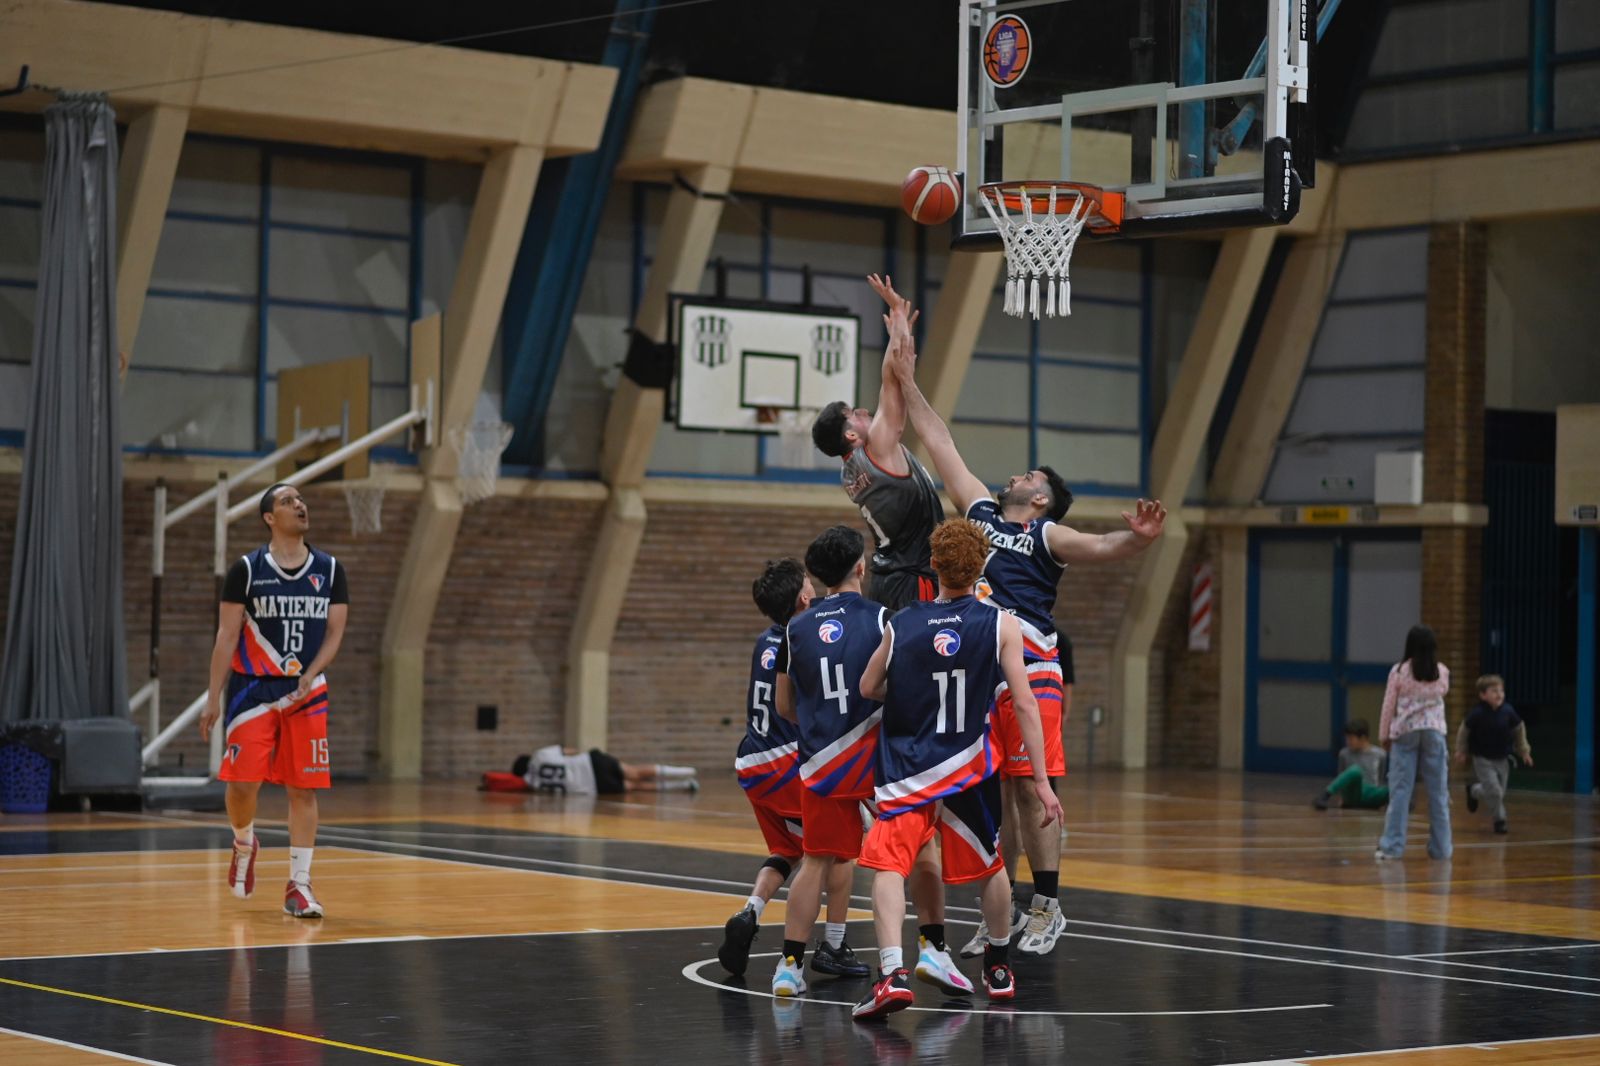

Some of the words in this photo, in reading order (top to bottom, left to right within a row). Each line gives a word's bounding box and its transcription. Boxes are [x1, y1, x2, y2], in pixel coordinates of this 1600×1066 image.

[1283, 151, 1291, 211] MIRAVET
[969, 518, 1035, 557] TIENZO
[281, 619, 305, 652] 15
[927, 614, 963, 626] playmaker
[752, 680, 773, 738] 5
[820, 656, 850, 715] 4
[932, 668, 966, 734] 11
[310, 737, 330, 765] 15
